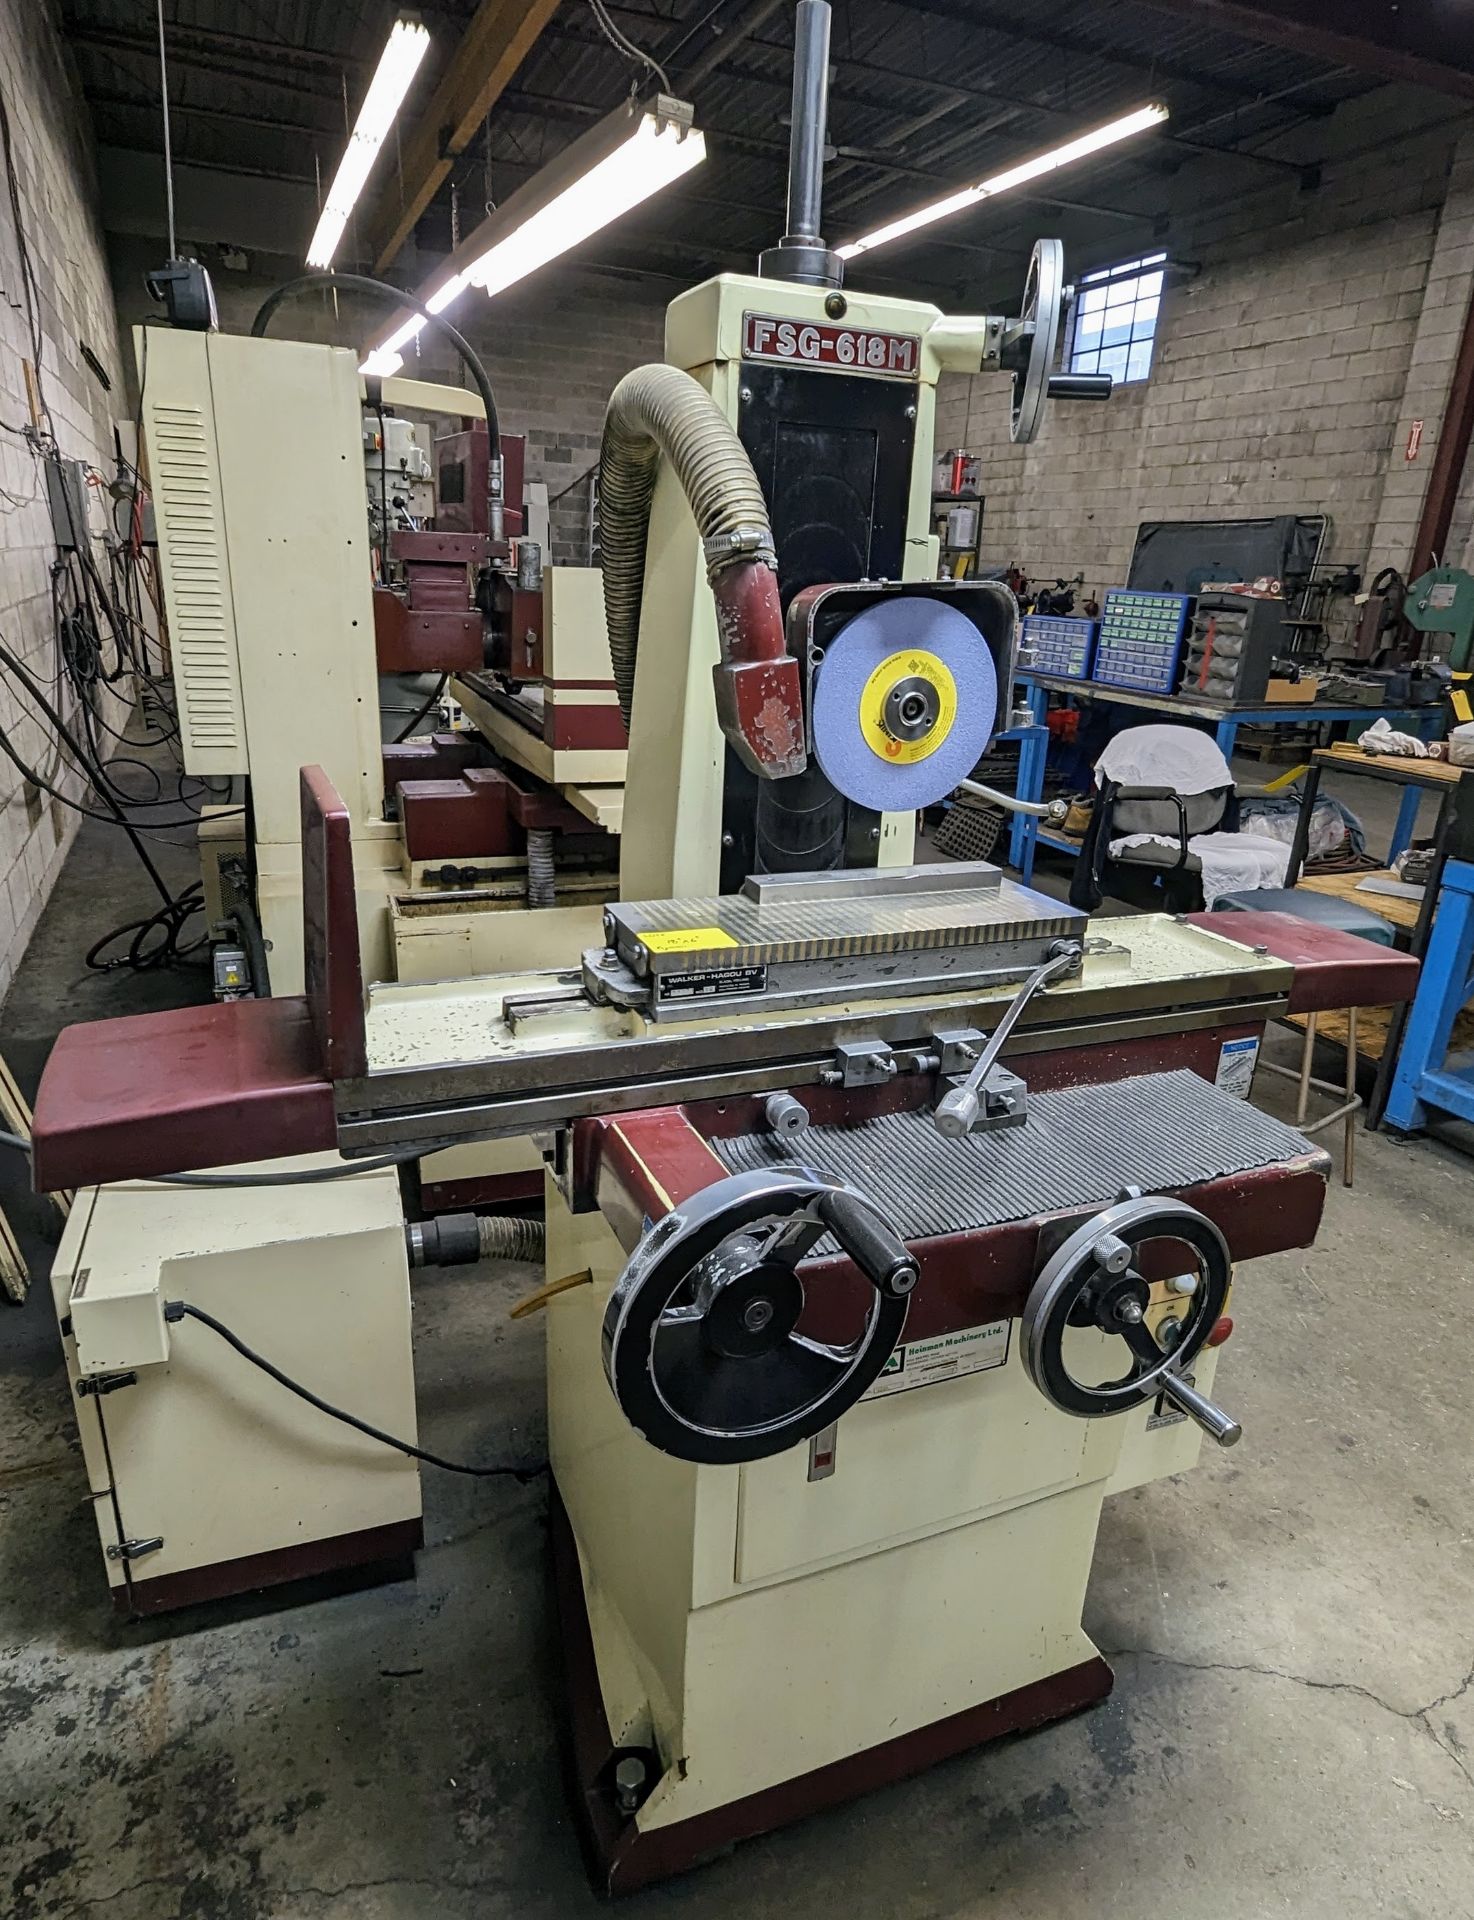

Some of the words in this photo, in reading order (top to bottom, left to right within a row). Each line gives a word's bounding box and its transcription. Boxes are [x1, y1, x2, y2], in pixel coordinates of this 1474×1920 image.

[754, 320, 912, 370] FSG-618M
[908, 1341, 944, 1356] Heinman
[945, 1332, 987, 1347] Machinery
[987, 1325, 1004, 1337] Ltd.
